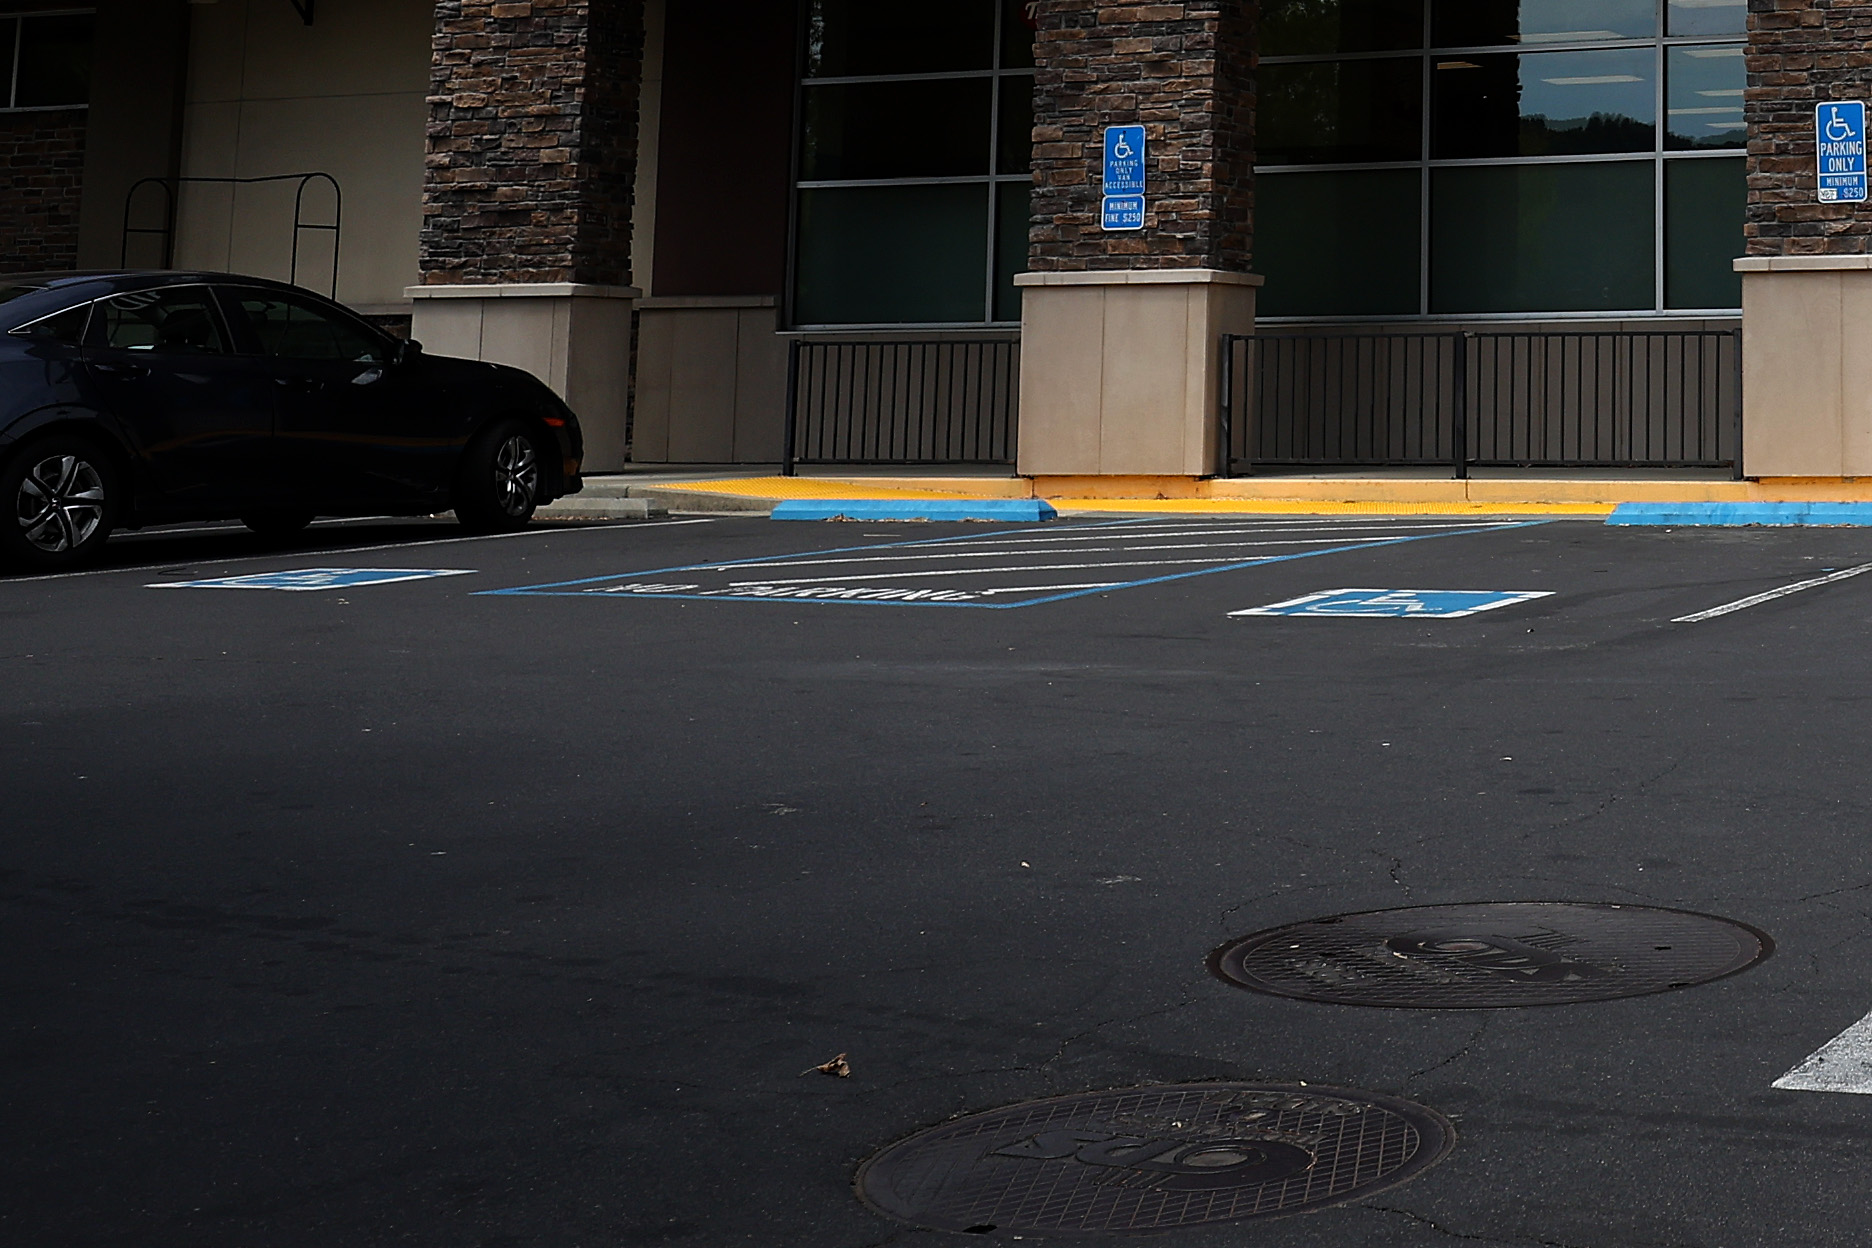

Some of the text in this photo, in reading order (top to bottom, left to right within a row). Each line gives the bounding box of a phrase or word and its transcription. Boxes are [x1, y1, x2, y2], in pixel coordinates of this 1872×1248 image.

[1820, 141, 1863, 157] PARKING
[1109, 159, 1139, 168] PARKING
[1828, 157, 1855, 172] ONLY
[1104, 180, 1144, 189] ACCESSIBLE
[1826, 176, 1859, 187] MINIMUM
[1842, 187, 1864, 198] $250
[1109, 201, 1138, 211] MINIMUM
[1104, 212, 1141, 223] FINE $250
